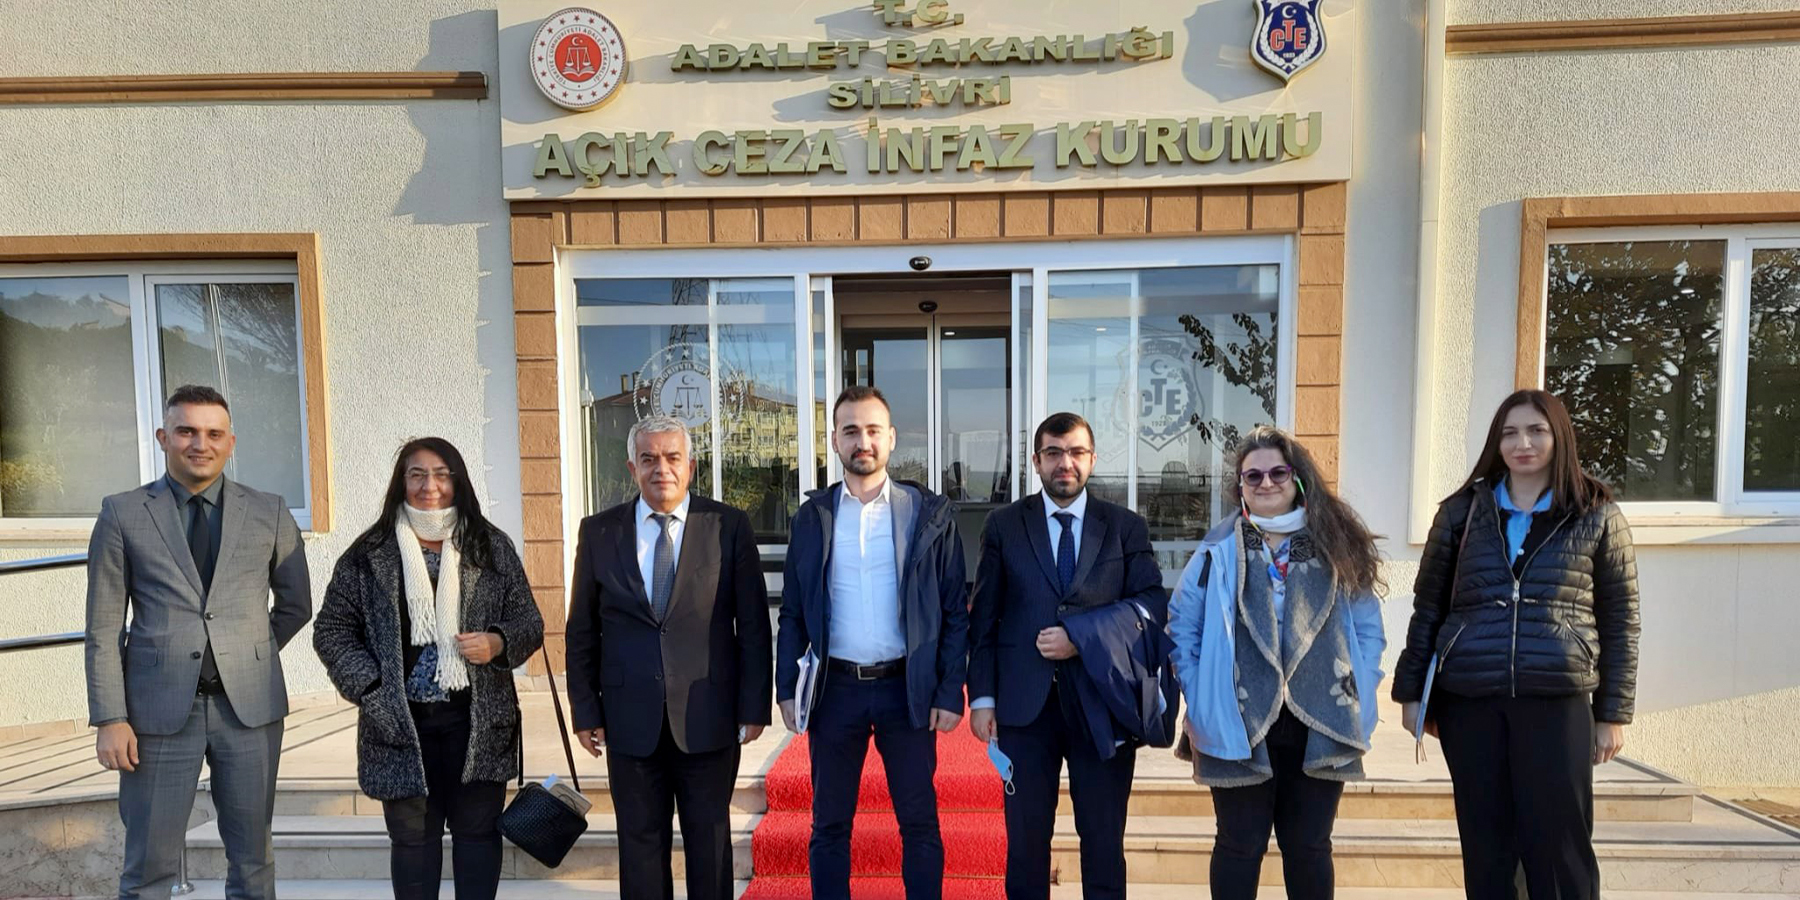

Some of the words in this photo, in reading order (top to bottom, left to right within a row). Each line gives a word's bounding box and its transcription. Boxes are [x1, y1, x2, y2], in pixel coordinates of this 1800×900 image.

[873, 0, 964, 27] T.C.
[583, 28, 604, 46] ADALET
[670, 41, 870, 72] ADALET
[886, 26, 1174, 67] BAKANLIĞI
[1270, 20, 1307, 51] CTE
[827, 71, 1011, 108] SİLİVRİ
[532, 131, 678, 189] AÇIK
[693, 129, 847, 177] CEZA
[866, 117, 1035, 174] İNFAZ
[1055, 111, 1323, 168] KURUMU
[1140, 378, 1182, 417] CTE
